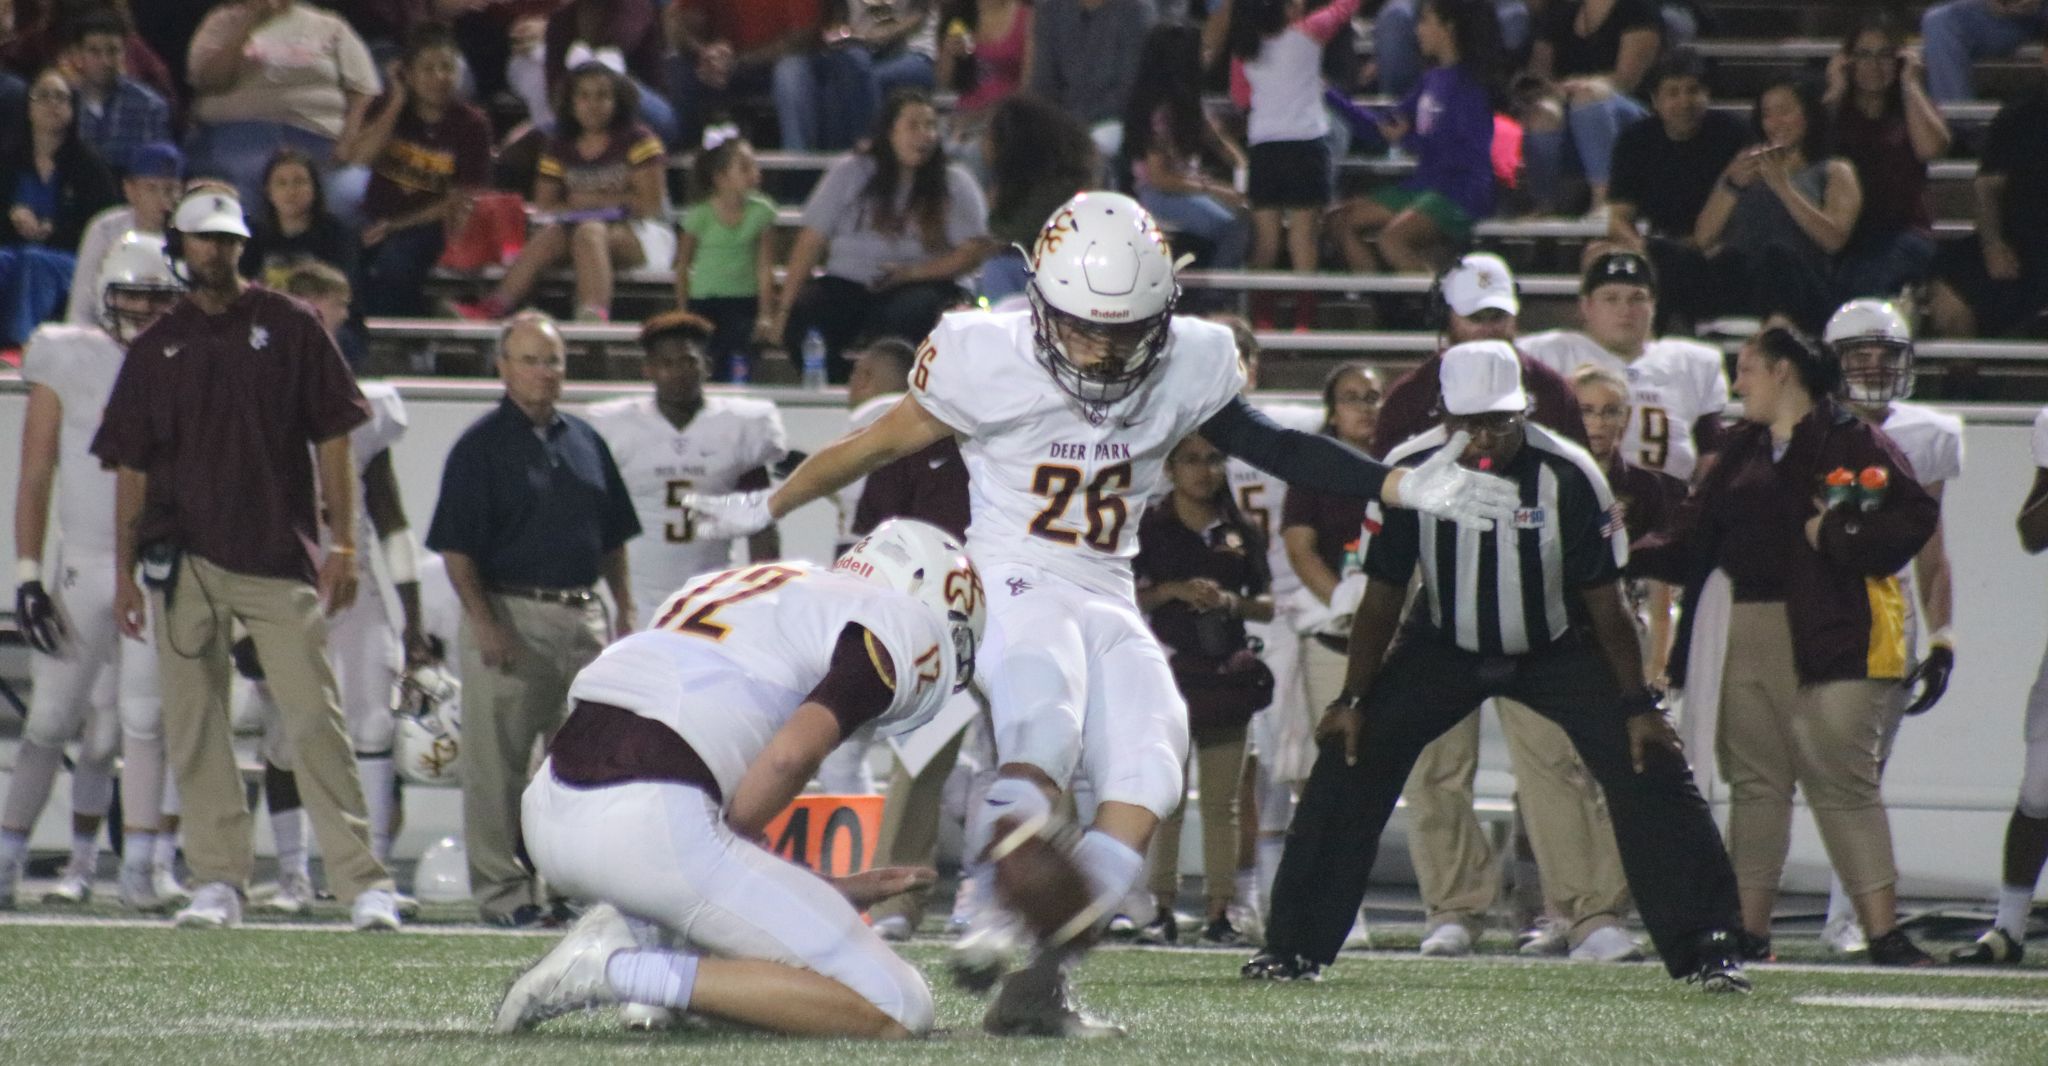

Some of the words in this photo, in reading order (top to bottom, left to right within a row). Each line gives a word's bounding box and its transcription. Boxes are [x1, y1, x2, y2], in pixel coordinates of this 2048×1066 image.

[1050, 442, 1087, 460] DEER
[1094, 443, 1131, 460] PARK
[1640, 406, 1669, 470] 9
[664, 479, 694, 543] 5
[1028, 461, 1132, 555] 26
[1239, 485, 1269, 532] 5
[833, 556, 875, 578] ddell
[653, 565, 807, 642] 12
[773, 805, 864, 875] 40
